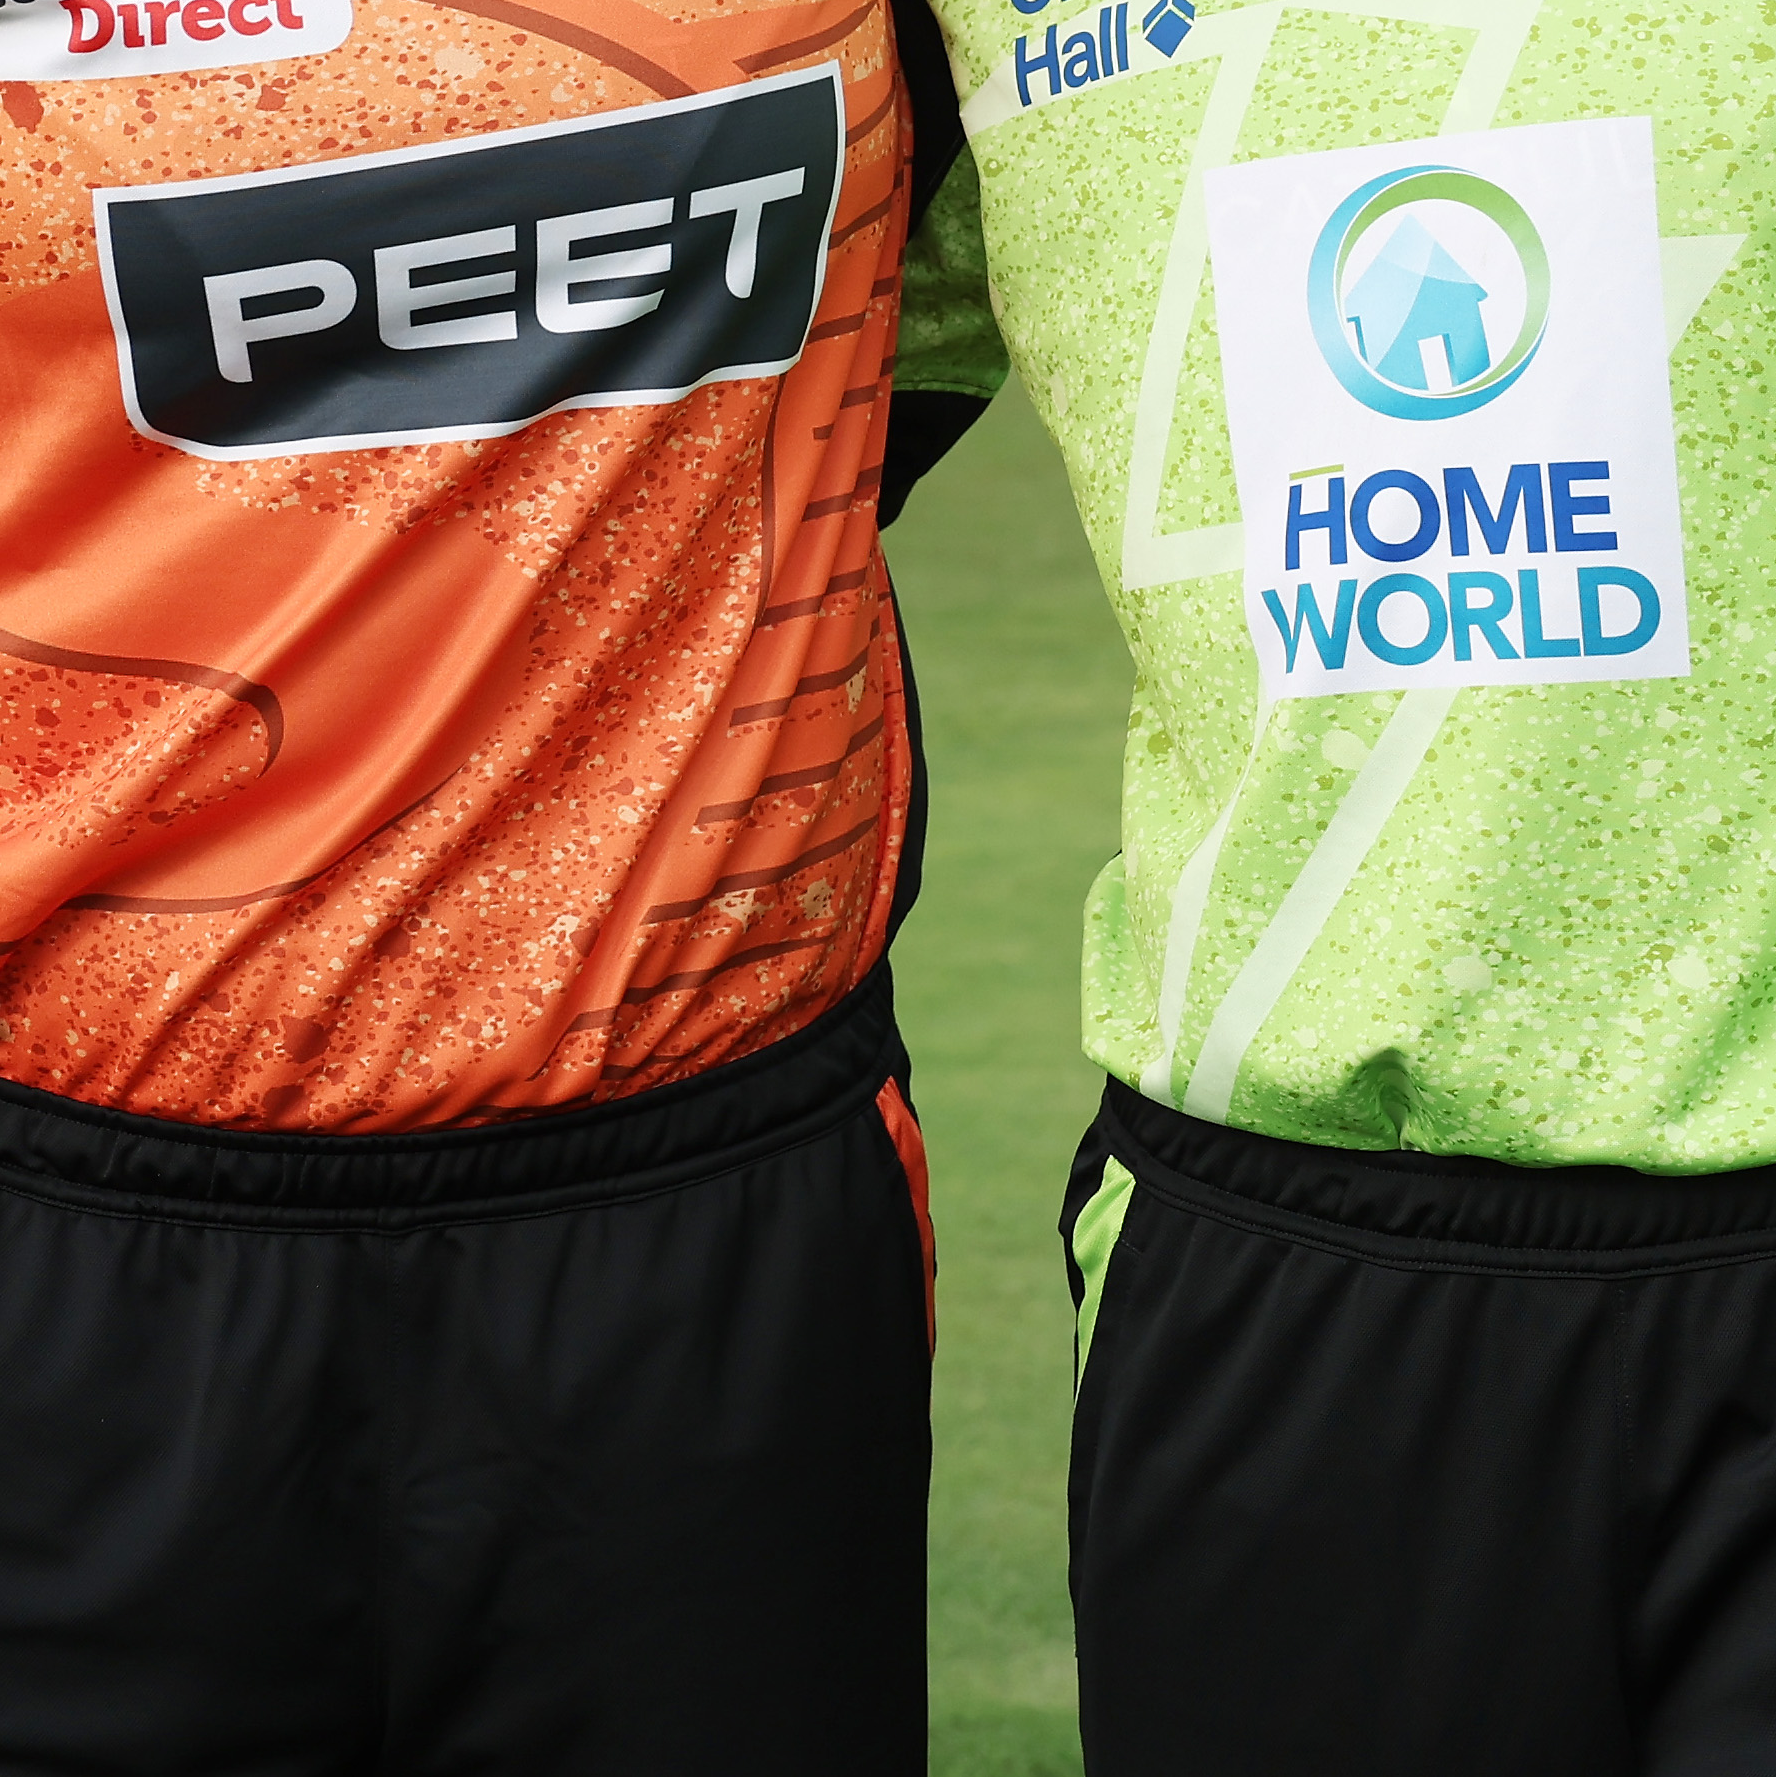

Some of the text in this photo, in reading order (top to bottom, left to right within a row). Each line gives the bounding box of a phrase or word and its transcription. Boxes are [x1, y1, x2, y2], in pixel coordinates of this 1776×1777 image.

[1014, 1, 1130, 108] Hall
[202, 166, 806, 383] PEET
[1285, 460, 1619, 571] HOME
[1261, 565, 1661, 674] WORLD
